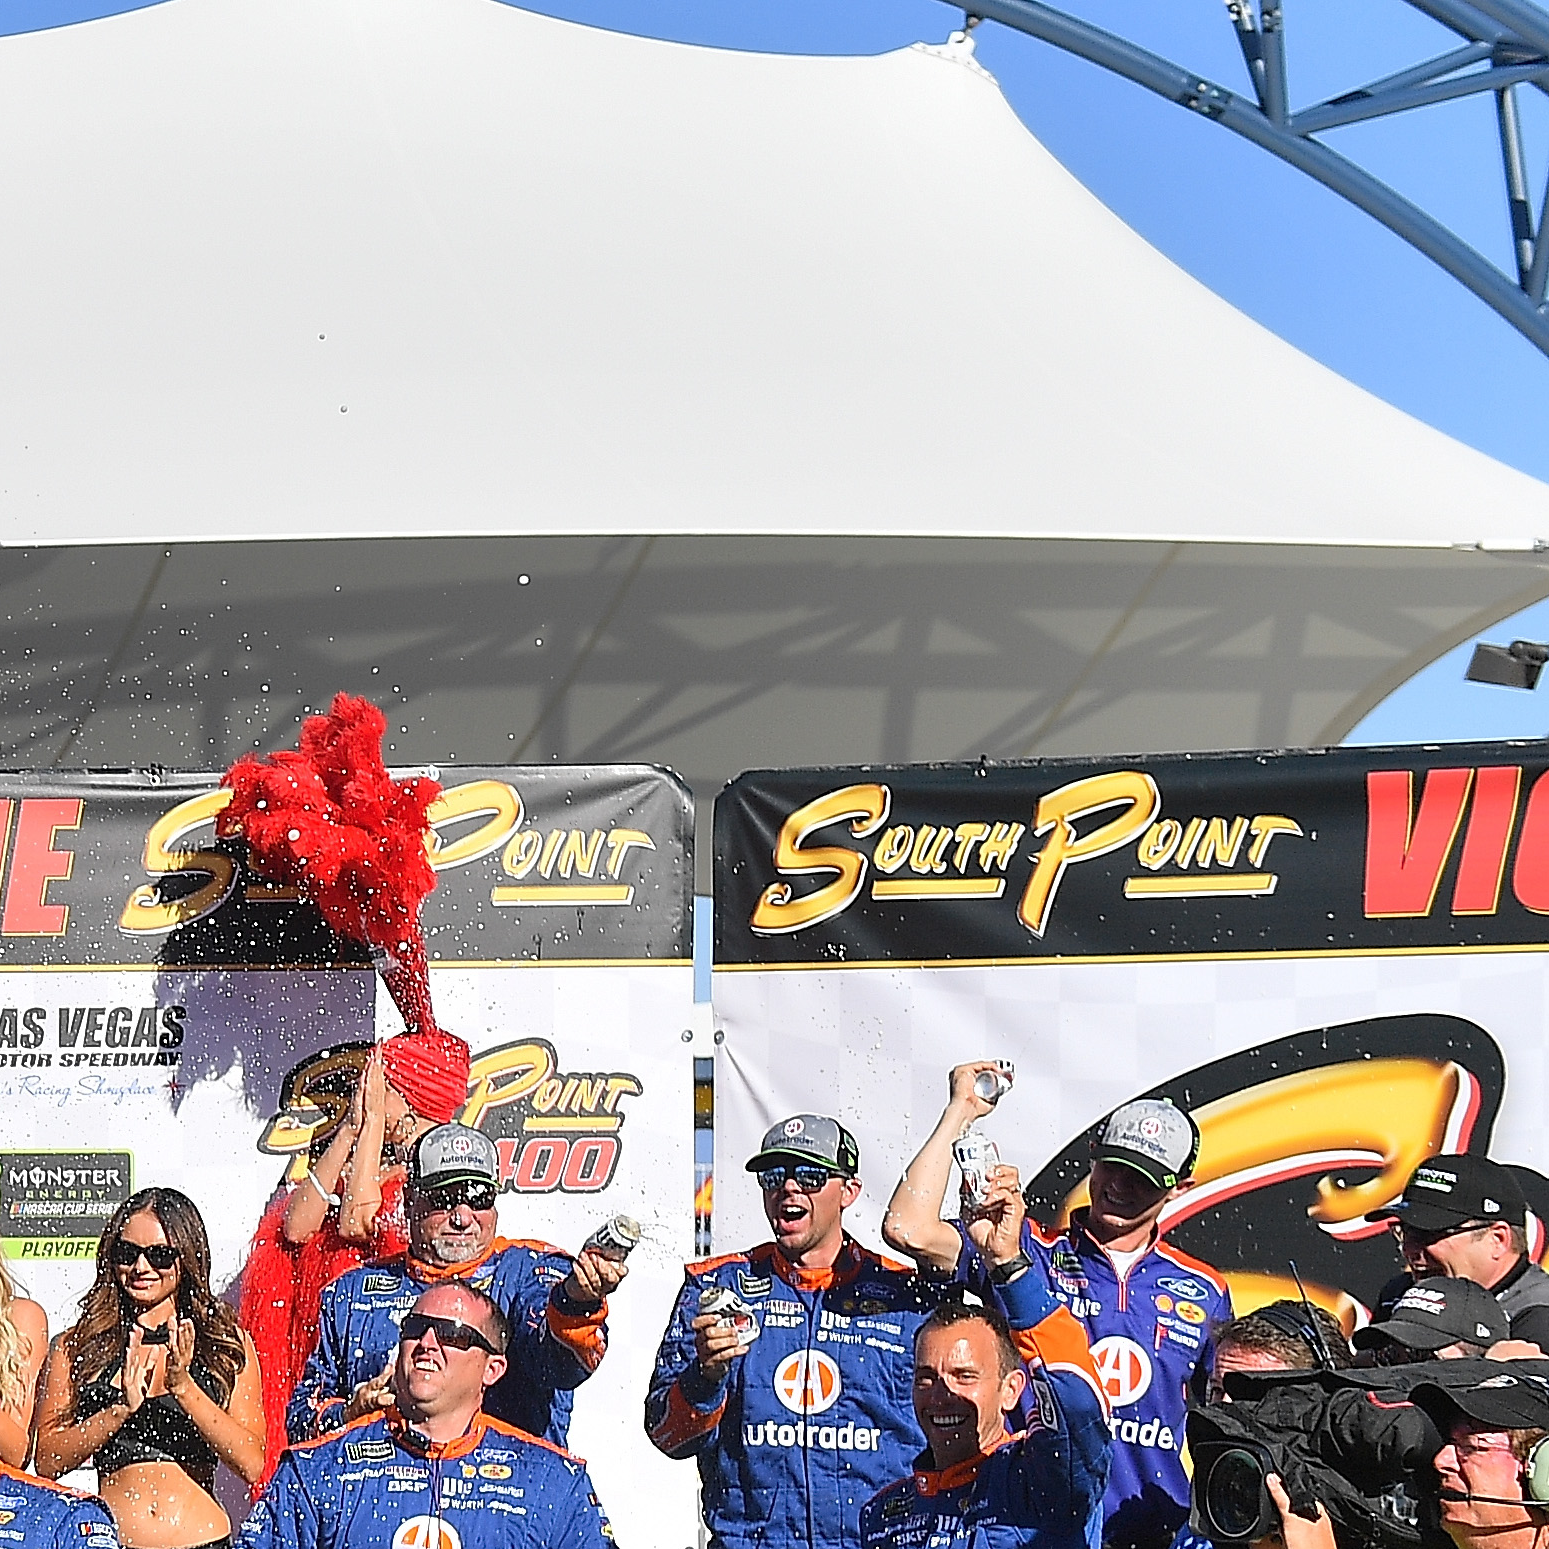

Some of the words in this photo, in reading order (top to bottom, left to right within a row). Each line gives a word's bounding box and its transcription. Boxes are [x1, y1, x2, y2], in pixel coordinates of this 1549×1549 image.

[750, 783, 1023, 937] SOUTH
[1016, 770, 1304, 938] POINT
[58, 1005, 186, 1049] VEGAS
[58, 1052, 183, 1068] SPEEDWAY
[18, 1075, 72, 1107] Racing
[8, 1166, 122, 1188] MONSTER
[22, 1241, 100, 1257] PLAYOFF
